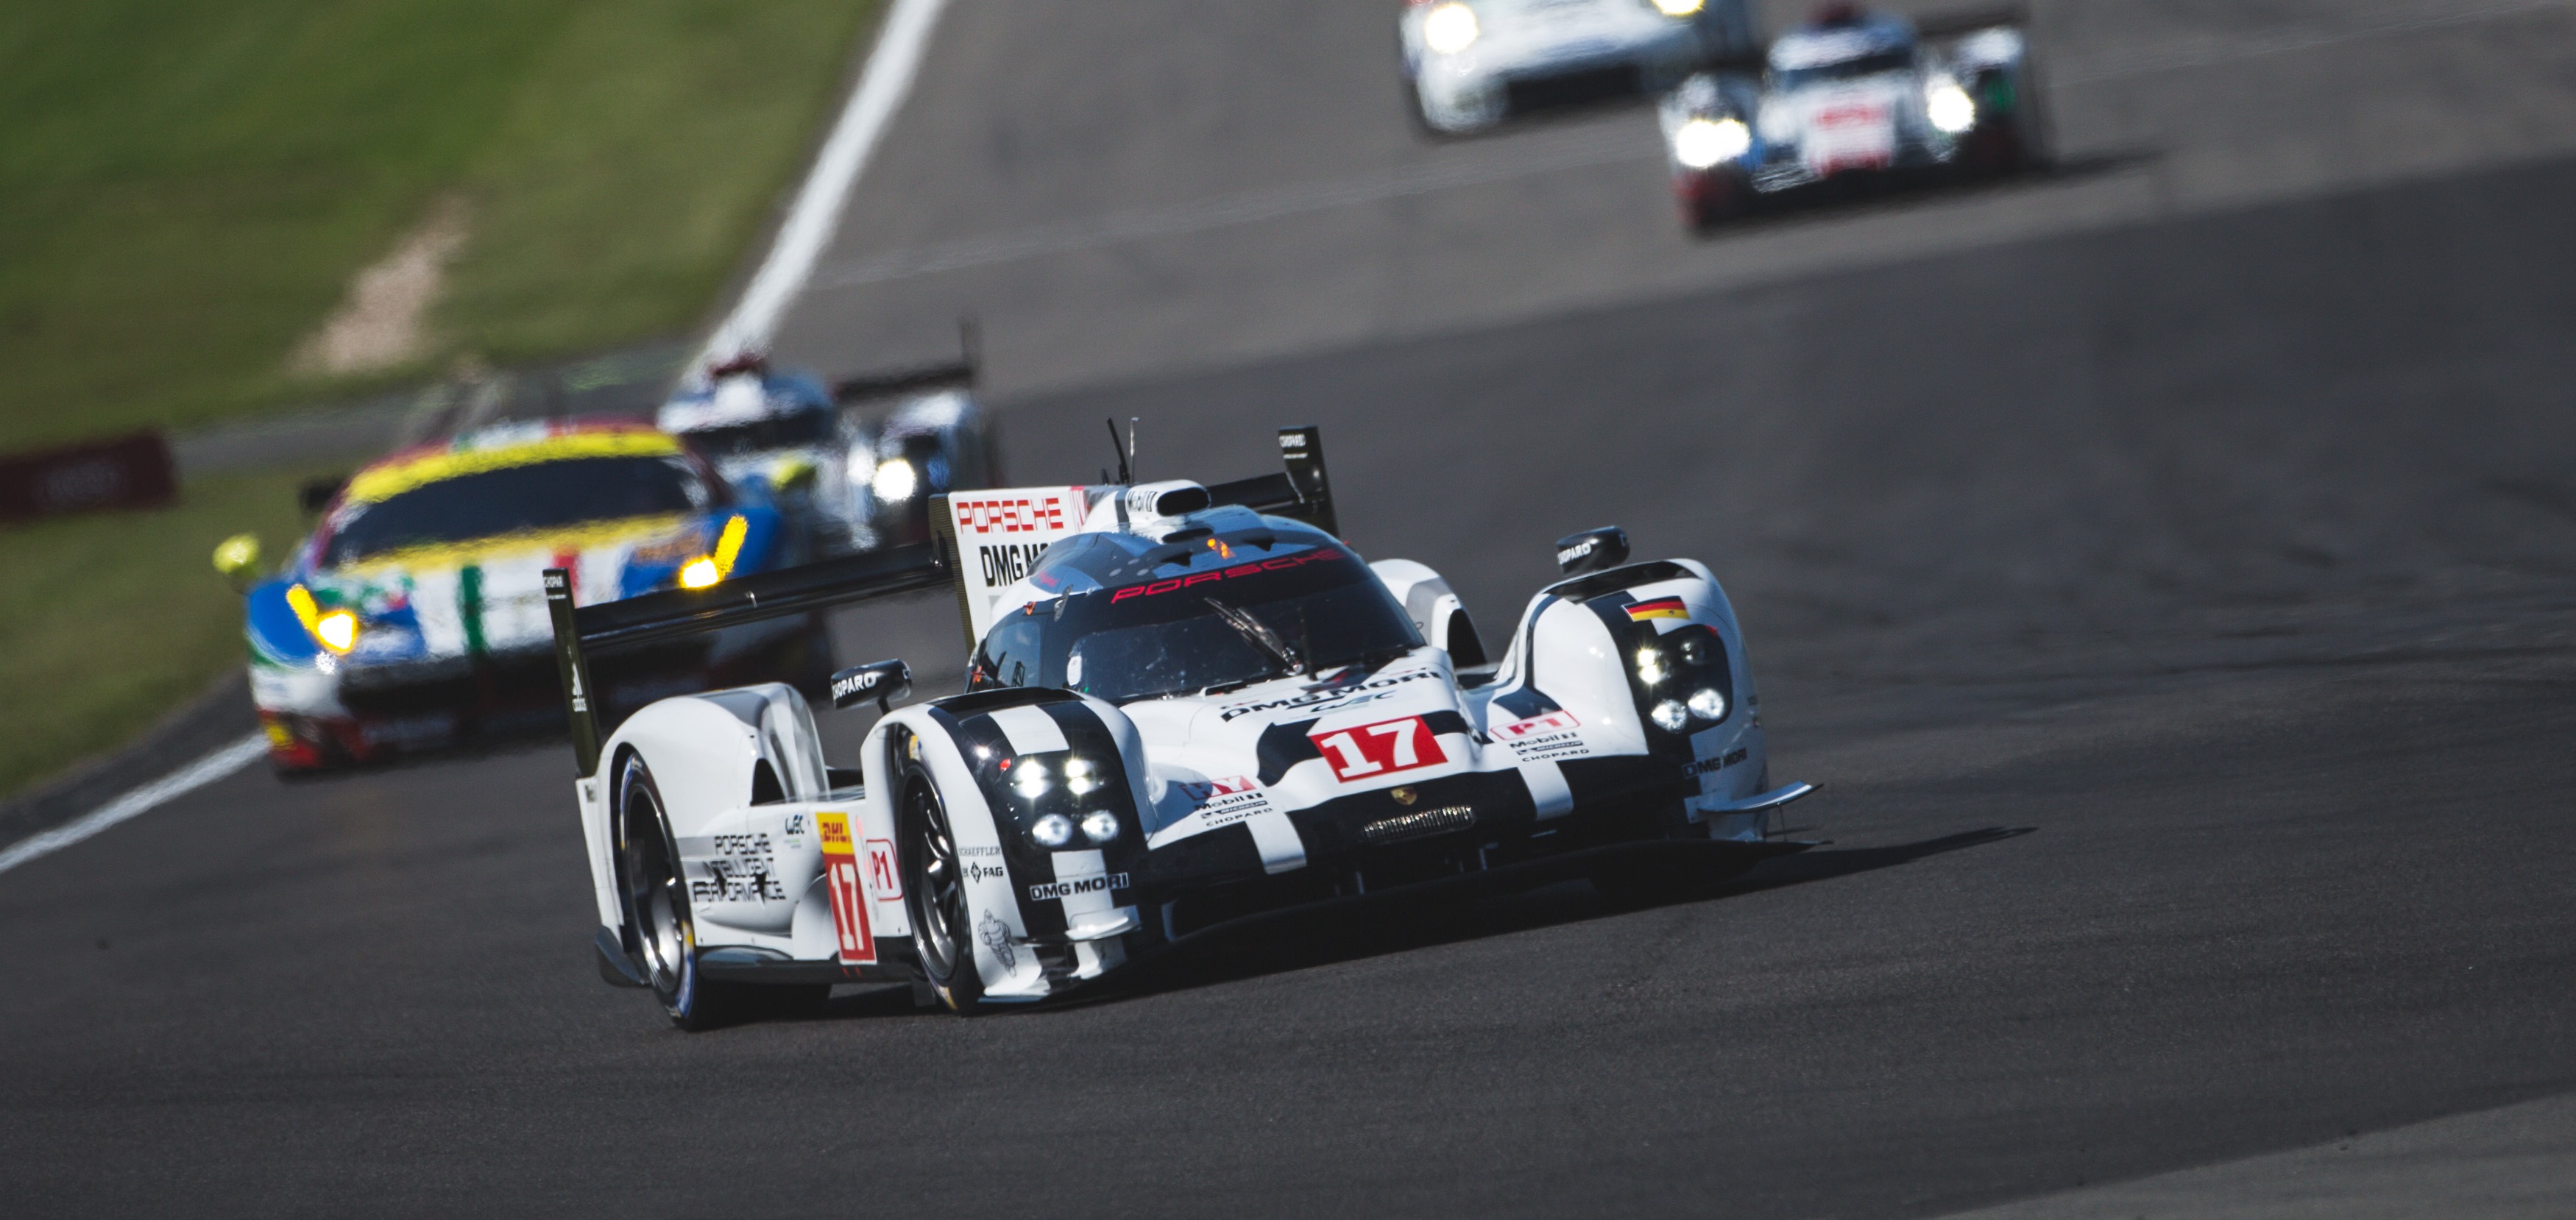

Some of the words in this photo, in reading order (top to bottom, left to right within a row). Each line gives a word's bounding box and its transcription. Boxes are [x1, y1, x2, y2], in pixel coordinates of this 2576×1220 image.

[956, 497, 1064, 534] PORSCHE
[979, 544, 1025, 587] DMG
[1110, 549, 1344, 604] PORSCHE
[1220, 691, 1320, 723] DMG
[1331, 671, 1442, 696] MORI
[1507, 717, 1563, 735] P1
[1320, 718, 1419, 779] 17
[1510, 734, 1560, 749] Mobil
[1522, 748, 1590, 762] CHOPARD
[1194, 795, 1245, 811] Mobil
[785, 815, 804, 834] WEC
[1206, 807, 1273, 827] CHOPARD
[822, 822, 851, 843] DHL
[715, 833, 772, 856] PORSCHE
[871, 851, 893, 890] P1
[983, 866, 1004, 878] FAG
[1031, 882, 1071, 900] DMG
[1075, 873, 1128, 894] MORI
[829, 862, 864, 951] 17
